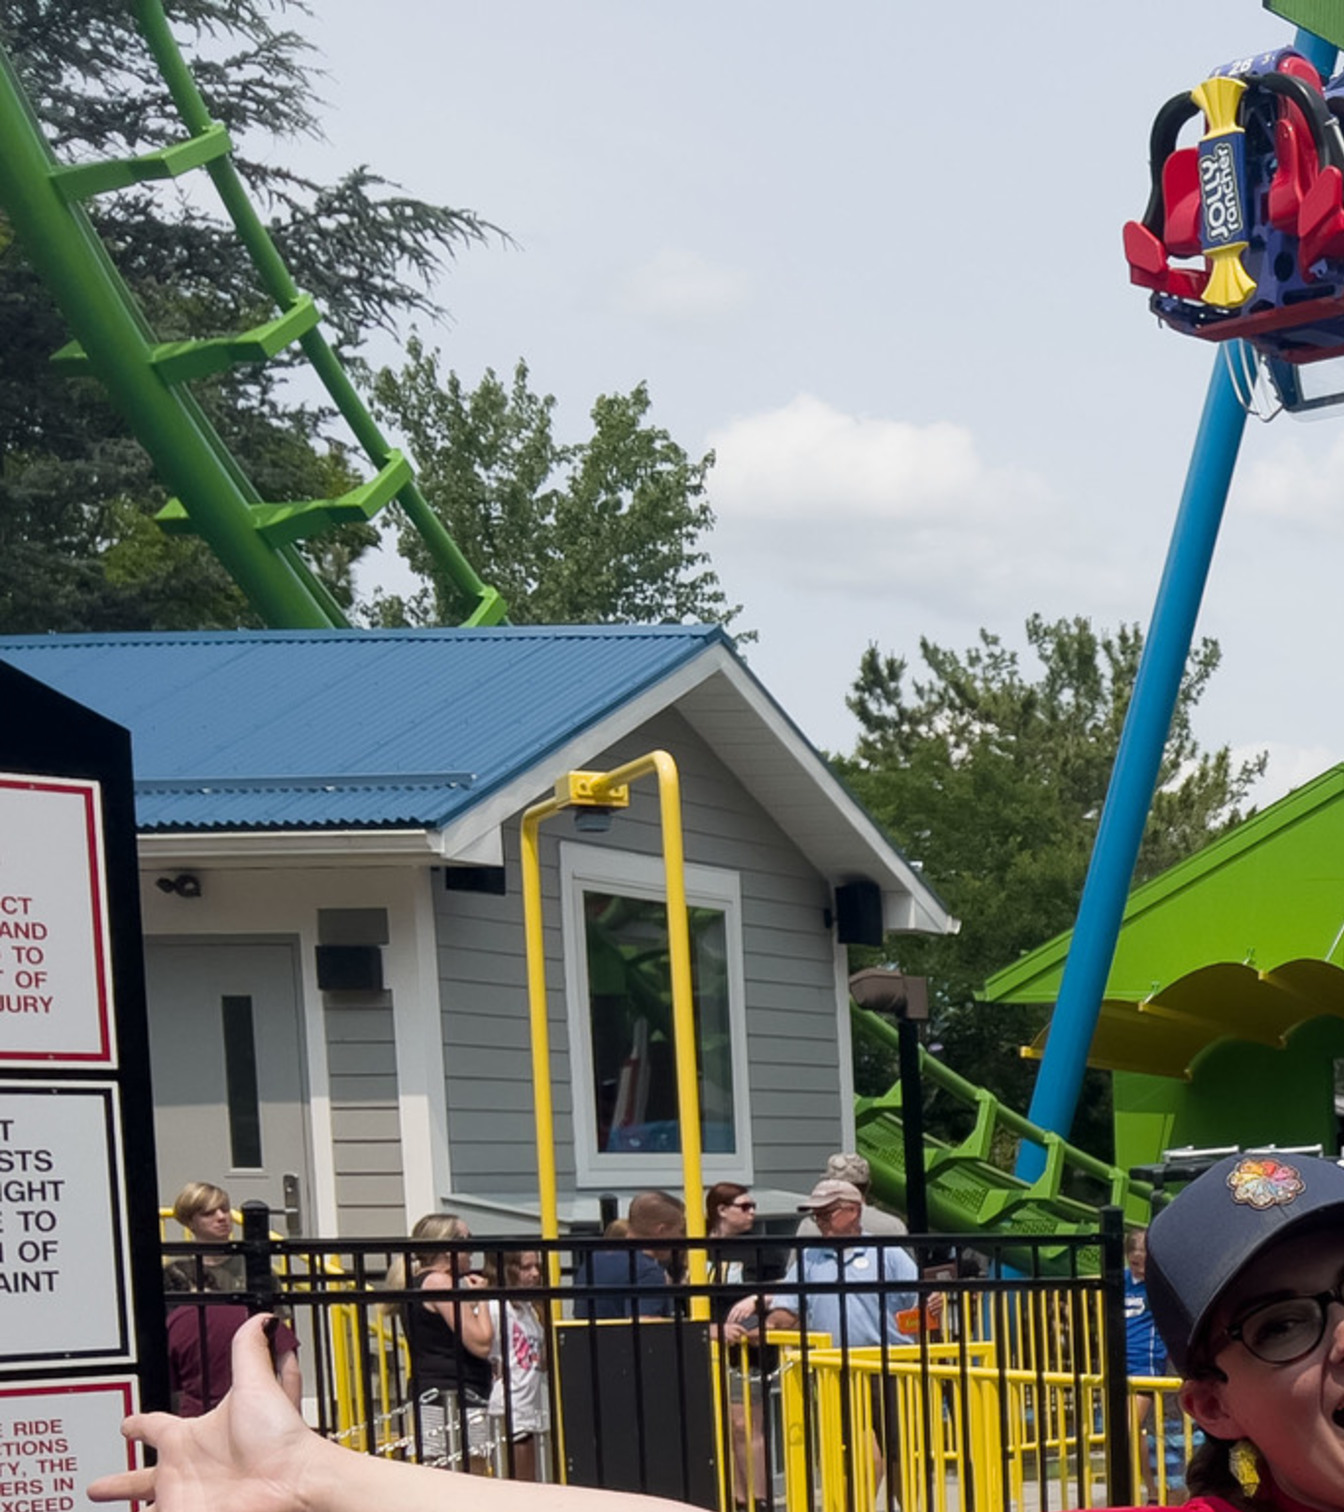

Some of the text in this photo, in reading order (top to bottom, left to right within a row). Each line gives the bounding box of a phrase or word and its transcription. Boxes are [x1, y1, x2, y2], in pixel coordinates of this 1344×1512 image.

[1217, 143, 1239, 231] rancher
[1201, 159, 1230, 239] JOLLY
[0, 921, 48, 941] AND
[11, 945, 44, 965] TO
[15, 970, 47, 989] OF
[16, 1210, 57, 1233] TO
[18, 1240, 58, 1263] OF
[13, 1419, 63, 1436] RIDE
[0, 1438, 68, 1456] TIONS
[36, 1457, 78, 1474] THE
[53, 1478, 74, 1492] IN
